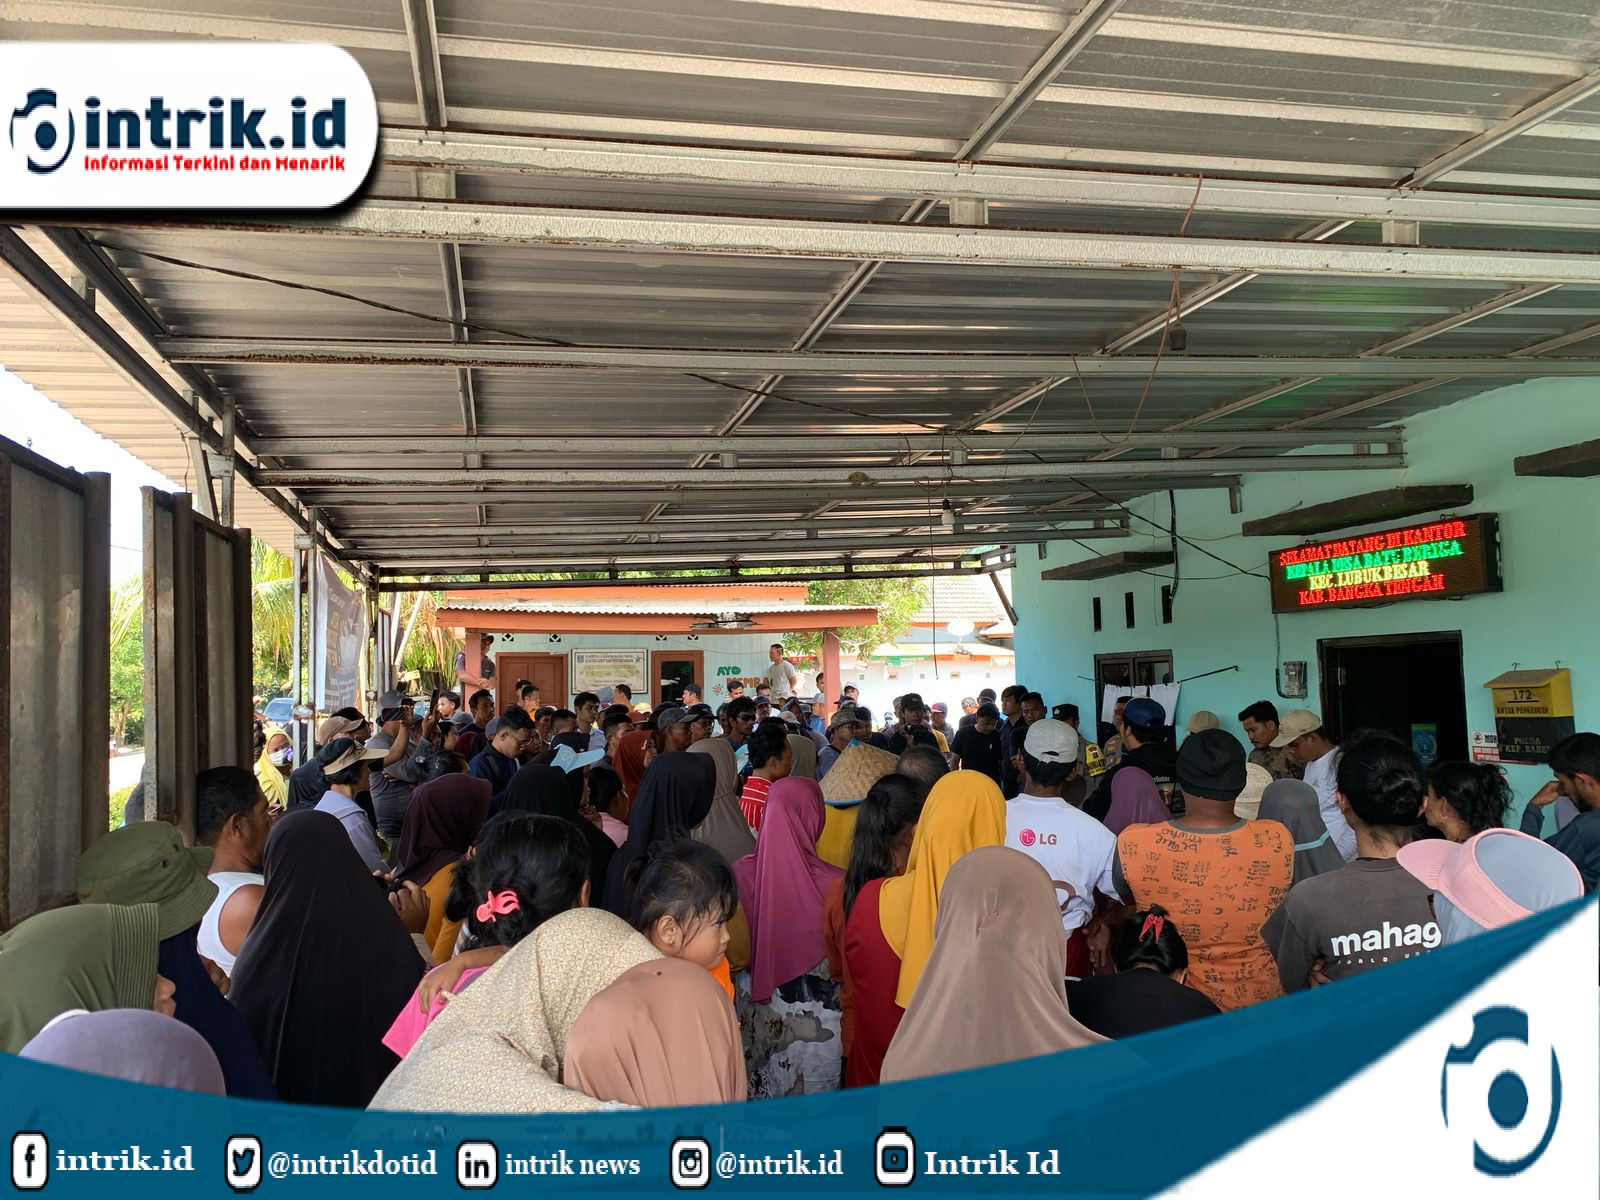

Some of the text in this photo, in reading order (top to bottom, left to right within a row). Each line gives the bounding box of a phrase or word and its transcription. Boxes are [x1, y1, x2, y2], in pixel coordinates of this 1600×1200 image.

[1279, 543, 1332, 566] SELAMAT
[1402, 520, 1467, 545] KANTOR
[1285, 560, 1331, 580] KEPALA
[1383, 560, 1430, 581] BESAR
[1327, 581, 1384, 602] BANGKA
[1383, 574, 1445, 596] TENGAH
[717, 666, 741, 676] AYO
[726, 677, 773, 688] MEMBA
[1513, 690, 1532, 700] 172
[1514, 737, 1541, 745] POLDA
[1039, 833, 1057, 845] LG
[1330, 921, 1442, 957] mahag
